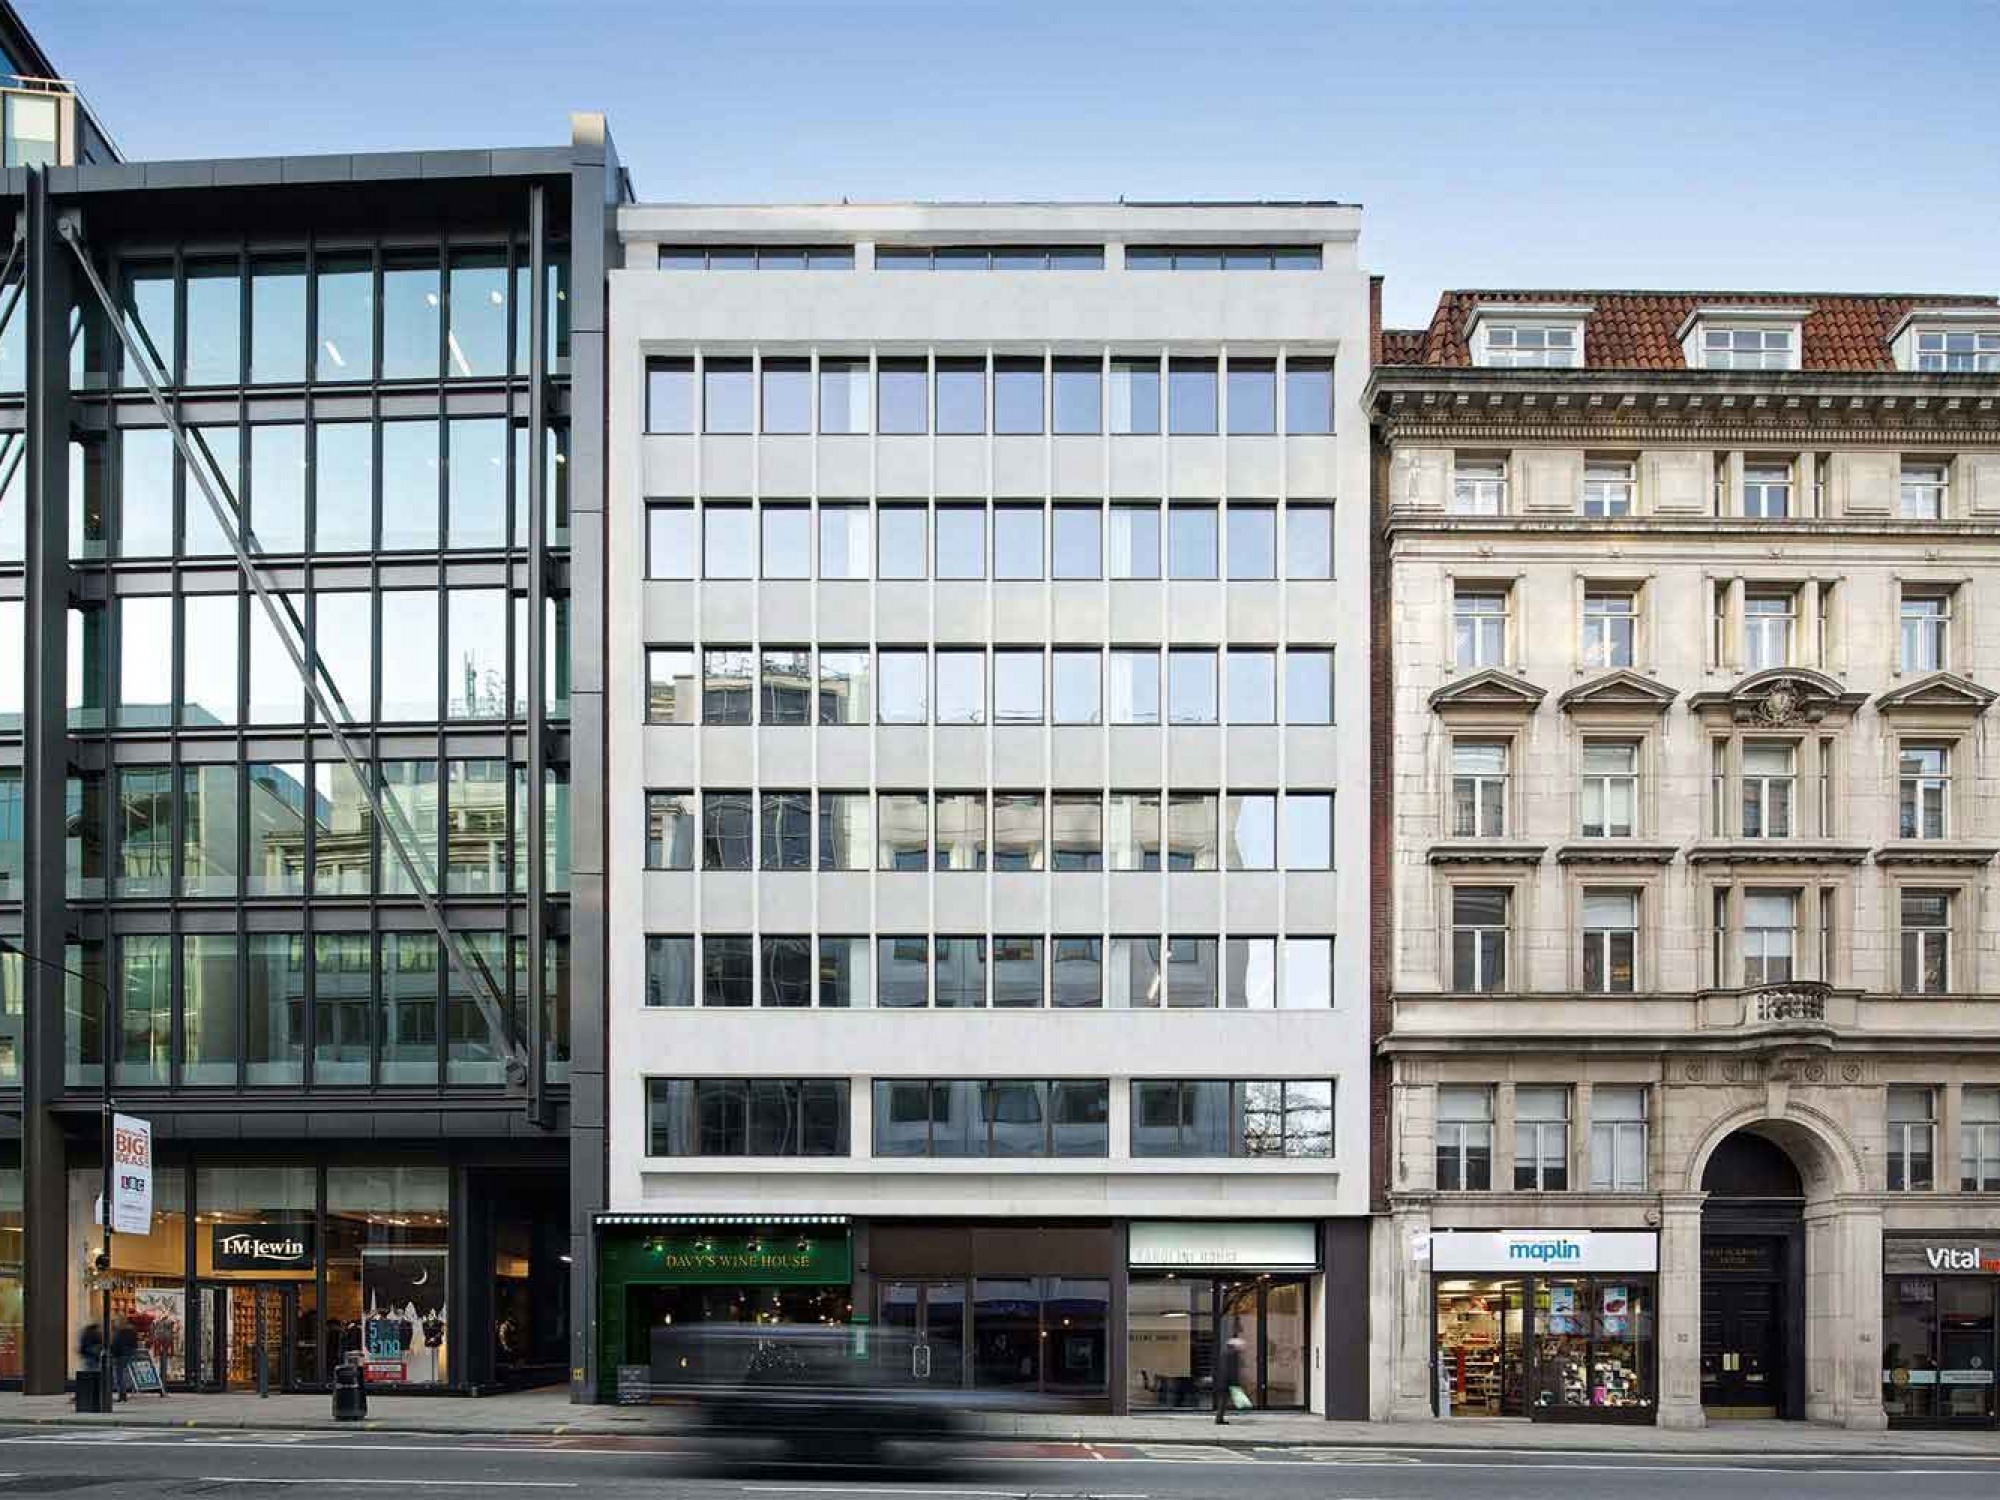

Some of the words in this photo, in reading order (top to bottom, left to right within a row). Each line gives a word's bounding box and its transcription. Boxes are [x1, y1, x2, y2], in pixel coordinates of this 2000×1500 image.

[116, 1133, 145, 1155] BIG
[666, 1254, 716, 1268] DAVY'S
[718, 1254, 757, 1268] WINE
[761, 1254, 810, 1268] HOUSE
[1510, 1239, 1580, 1262] maplin
[1926, 1247, 1980, 1269] Vital
